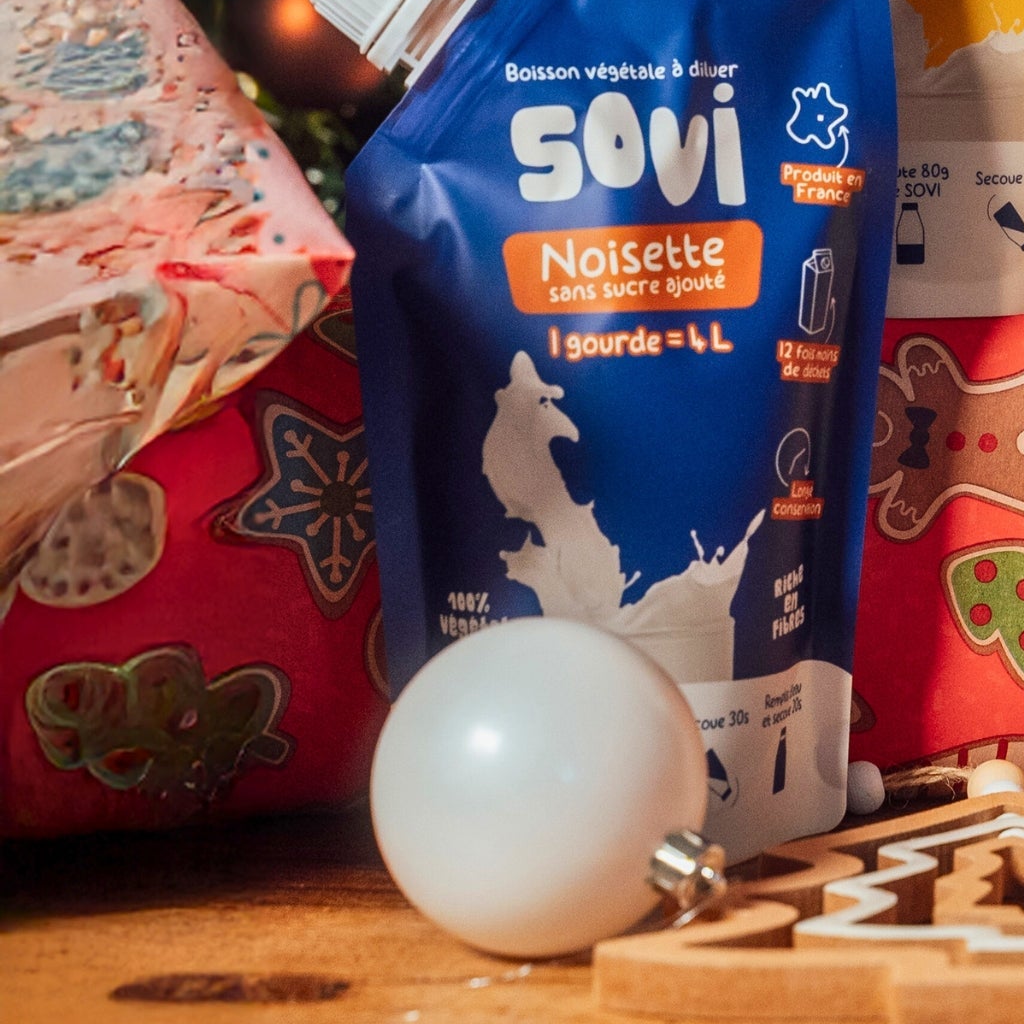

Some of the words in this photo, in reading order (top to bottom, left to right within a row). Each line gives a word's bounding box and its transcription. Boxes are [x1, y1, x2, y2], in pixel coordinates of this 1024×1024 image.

[505, 62, 580, 83] Boisson
[584, 61, 666, 83] végétale
[671, 58, 684, 78] à
[688, 61, 739, 79] diluer
[783, 164, 843, 185] Produit
[847, 174, 863, 187] en
[921, 162, 950, 181] 80g
[975, 171, 1023, 186] Secoue
[796, 182, 851, 204] France
[905, 182, 942, 198] SOVI
[541, 233, 725, 283] Noisette
[549, 283, 597, 303] sans
[602, 279, 660, 299] sucre
[666, 269, 726, 299] ajouté
[564, 327, 662, 360] gourde
[689, 324, 706, 353] 4
[713, 322, 732, 351] L
[779, 341, 792, 359] 12
[796, 343, 815, 361] fois
[783, 361, 800, 378] de
[447, 592, 490, 613] 100%
[784, 591, 798, 613] en
[729, 709, 750, 726] 30s
[762, 714, 772, 728] et
